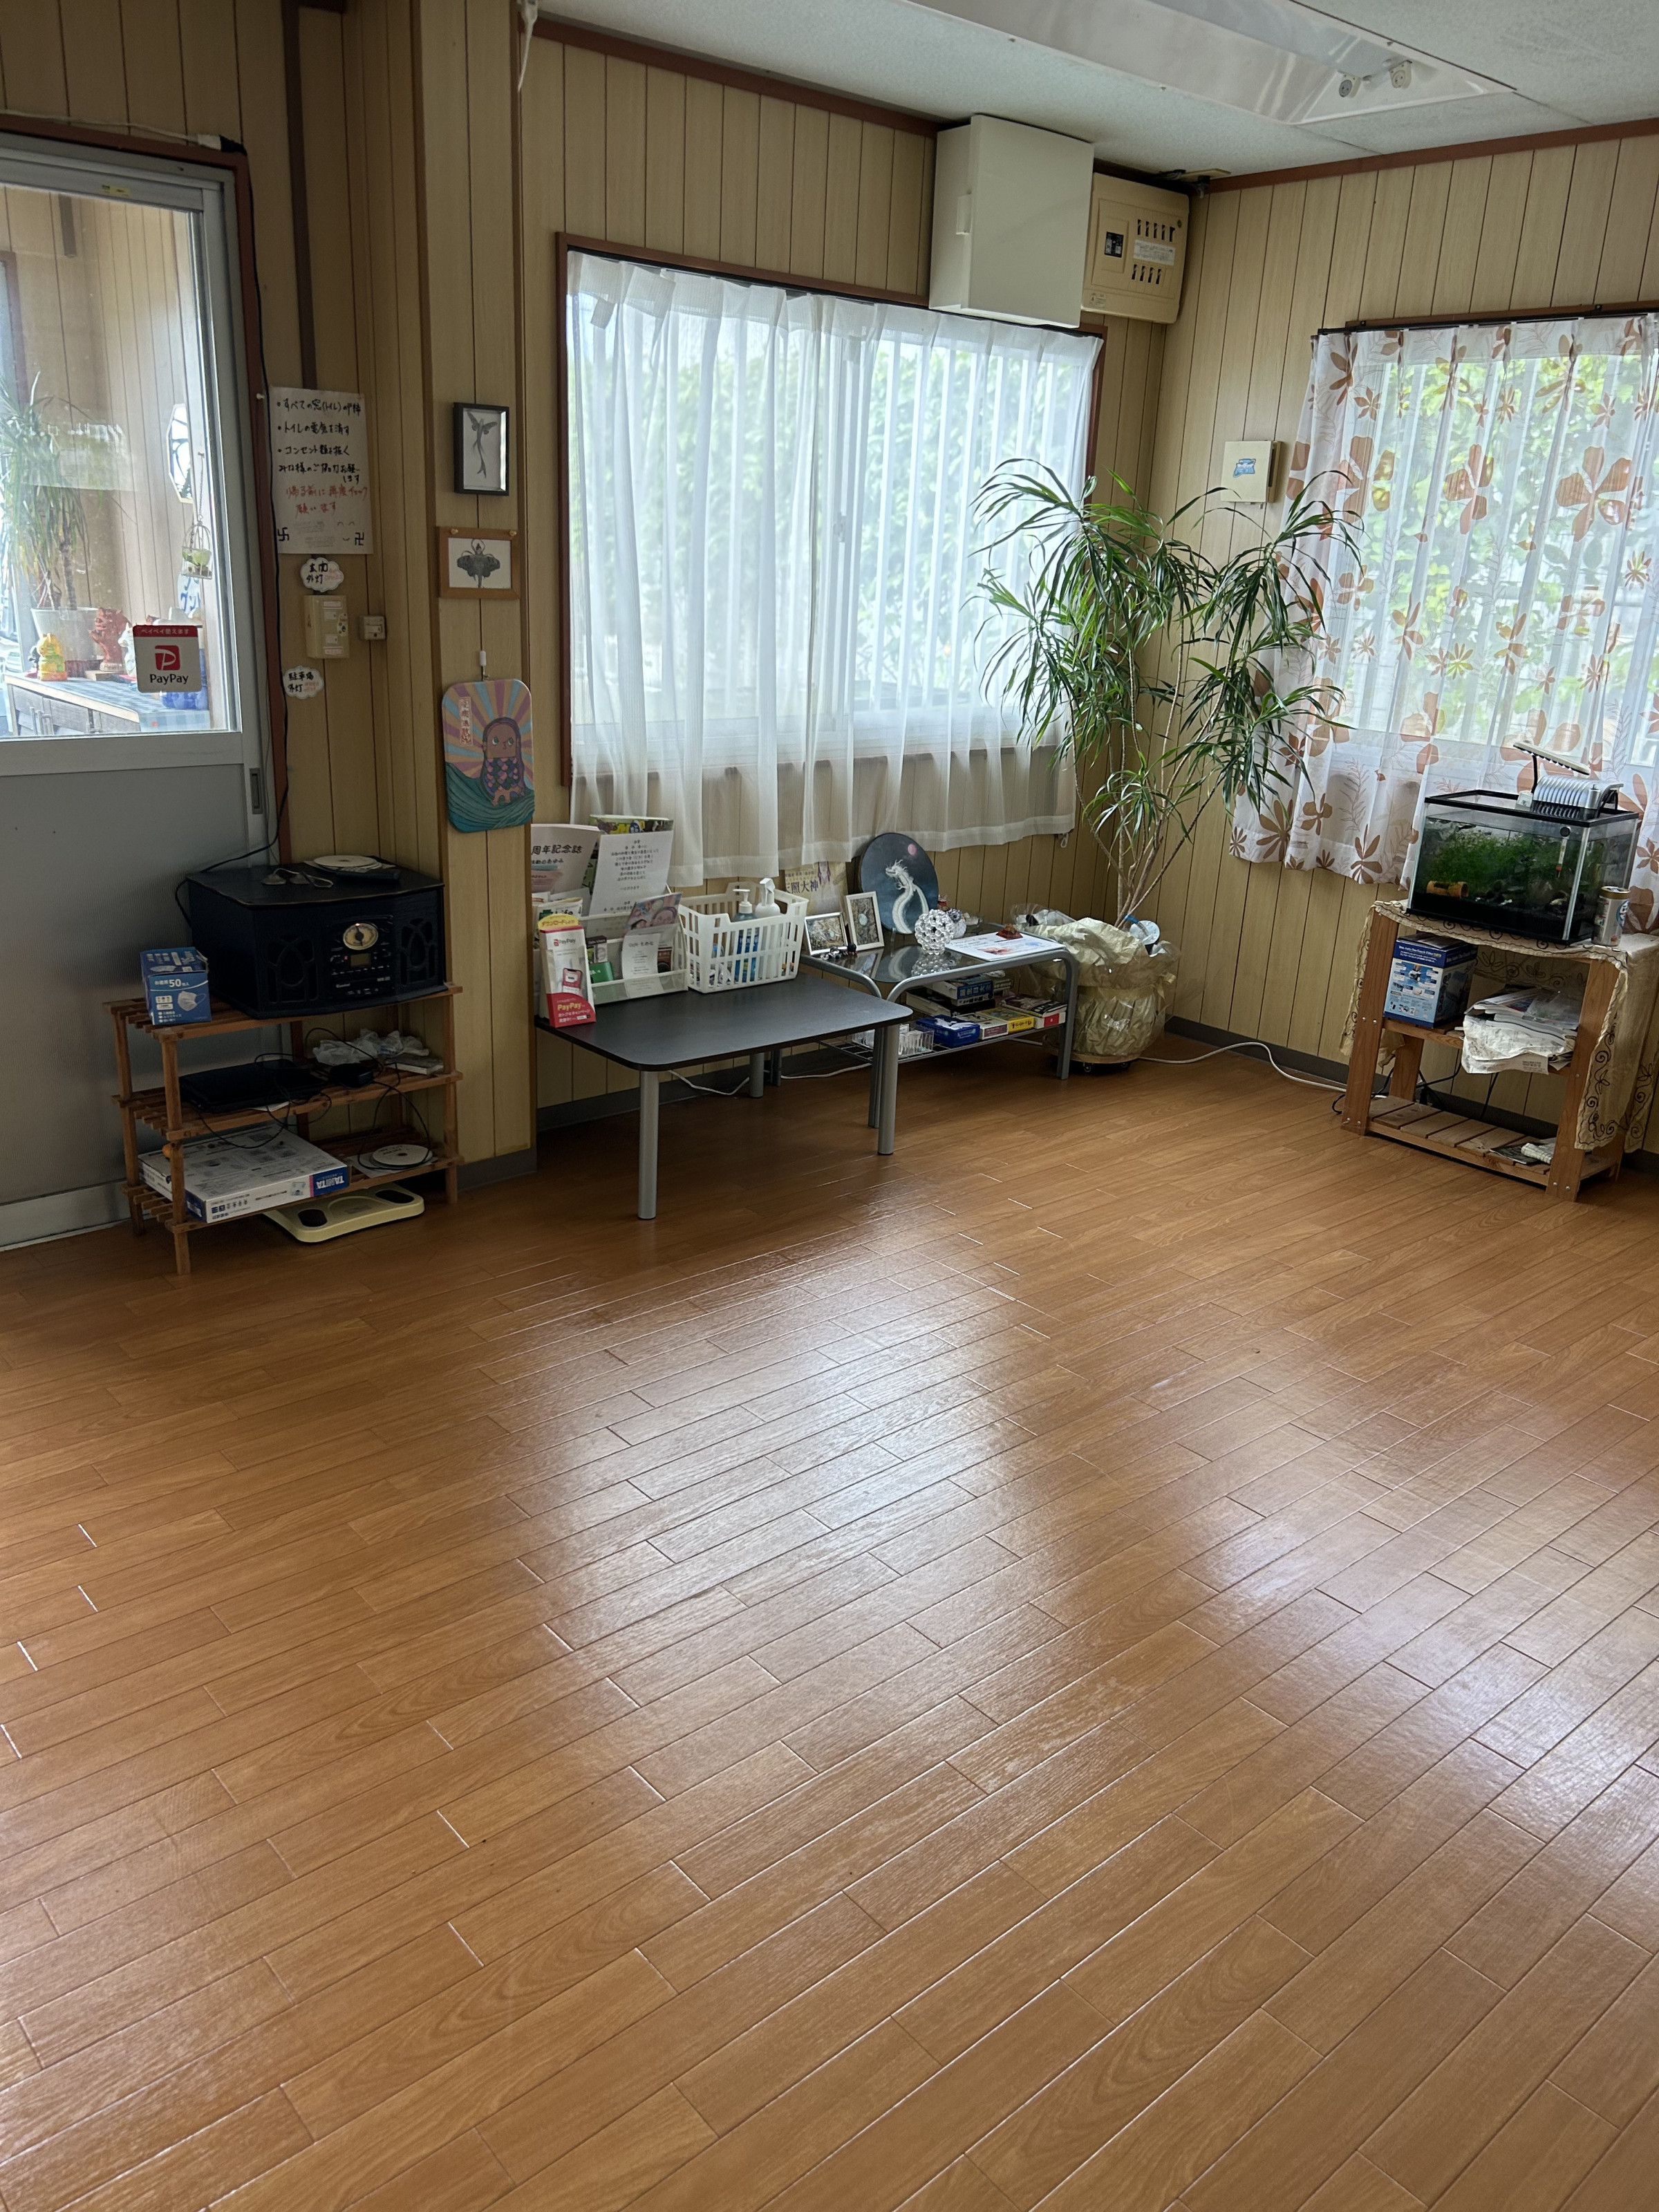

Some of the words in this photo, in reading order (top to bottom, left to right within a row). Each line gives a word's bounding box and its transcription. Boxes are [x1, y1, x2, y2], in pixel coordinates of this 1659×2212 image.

[306, 574, 324, 585] 外灯
[149, 673, 189, 685] PayPay
[288, 671, 315, 682] 駐車場
[287, 683, 304, 693] 外灯
[556, 1002, 582, 1011] PayPay
